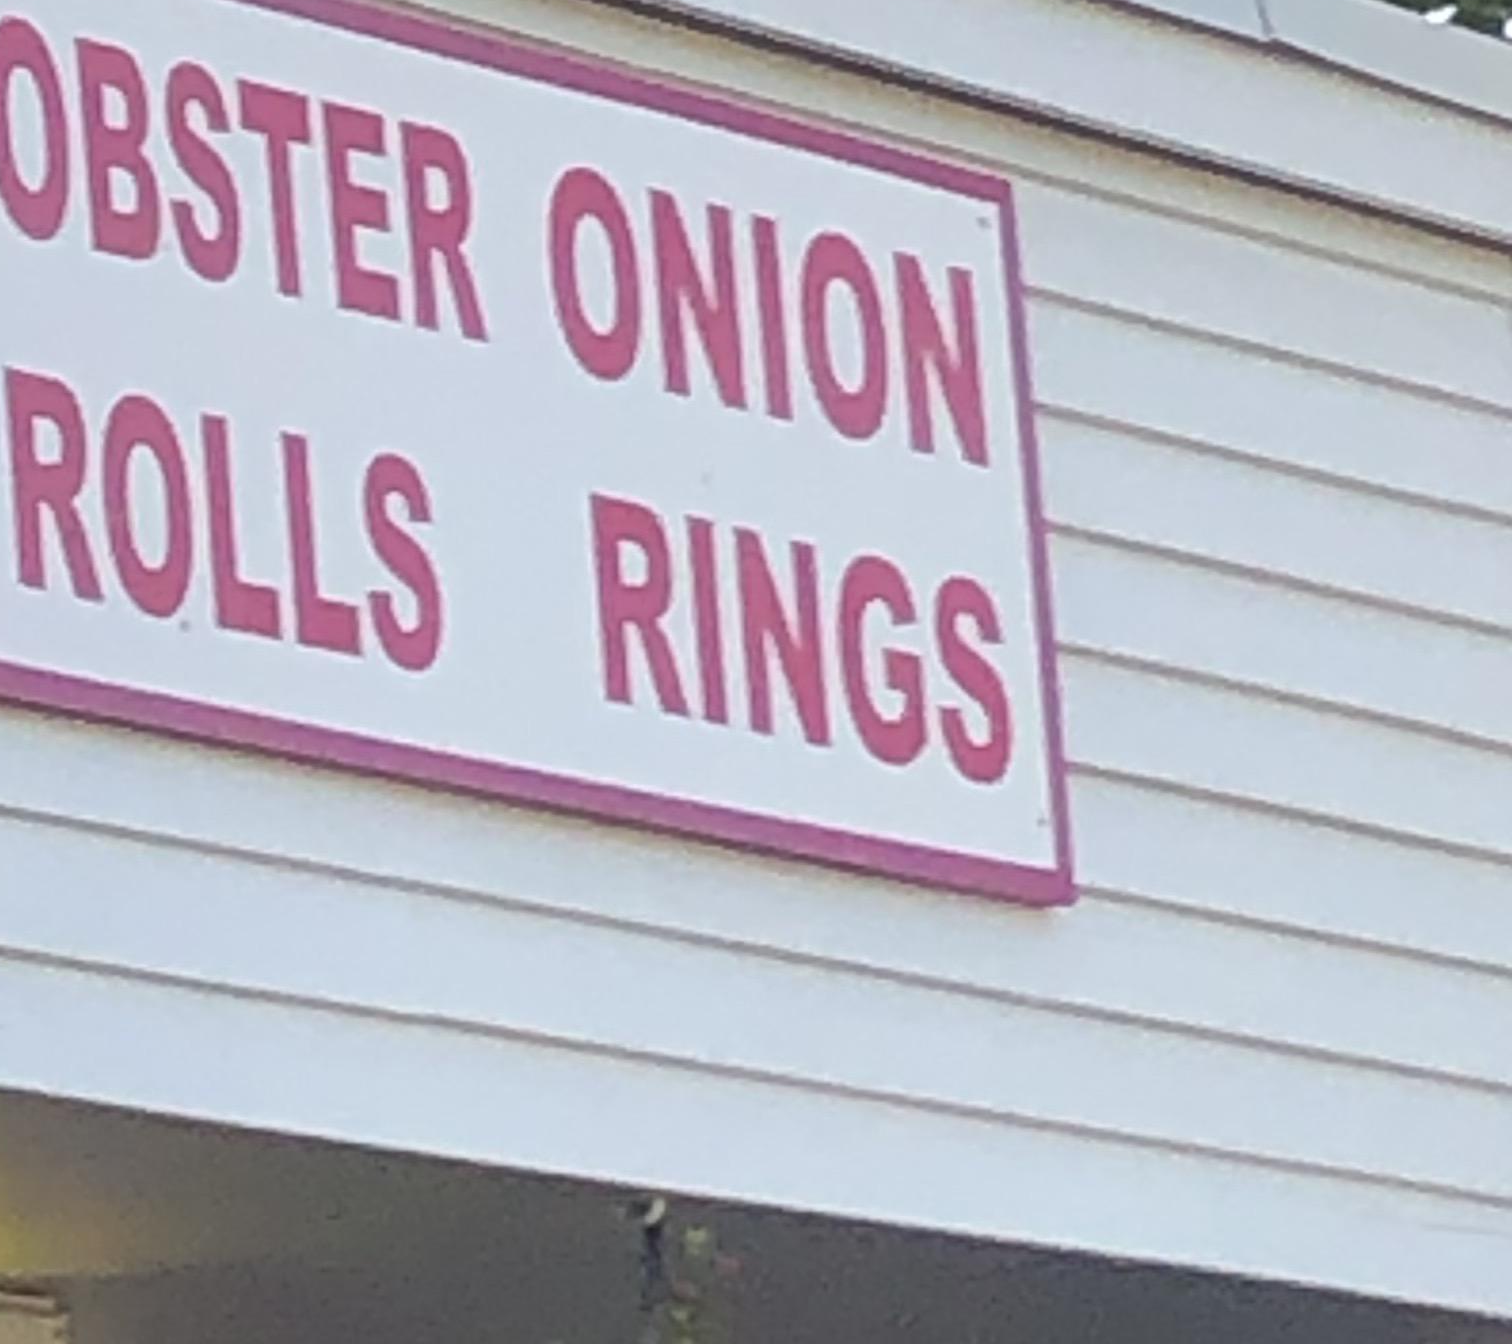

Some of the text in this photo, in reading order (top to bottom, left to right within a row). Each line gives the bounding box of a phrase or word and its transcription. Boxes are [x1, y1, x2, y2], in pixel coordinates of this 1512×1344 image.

[548, 166, 990, 467] ONION
[4, 365, 444, 671] ROLLS
[590, 493, 1014, 783] RINGS
